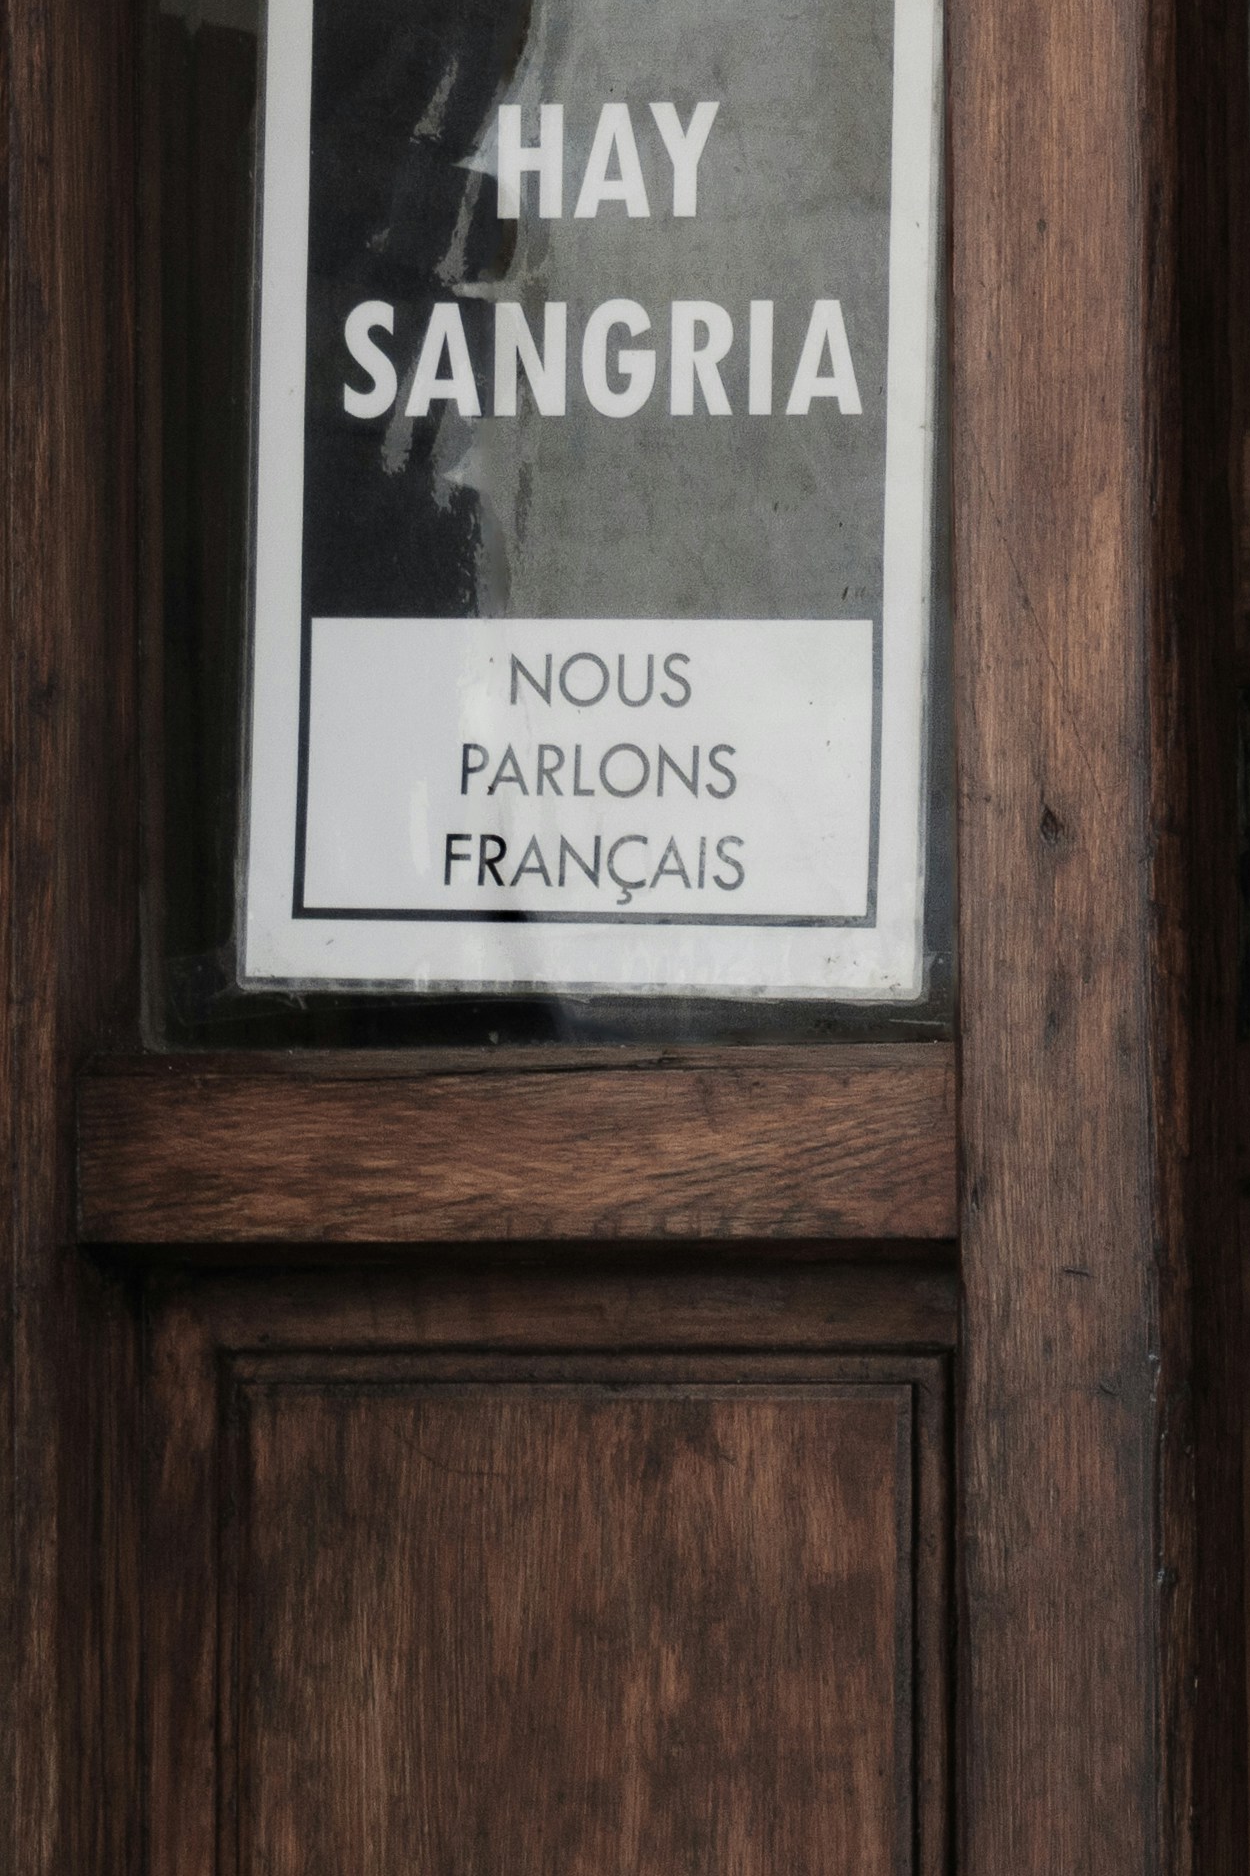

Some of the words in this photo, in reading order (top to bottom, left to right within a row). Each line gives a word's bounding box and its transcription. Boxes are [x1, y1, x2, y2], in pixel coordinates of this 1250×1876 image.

[497, 102, 720, 219] HAY
[343, 299, 863, 419] SANGRIA
[509, 652, 693, 708] NOUS
[460, 742, 738, 800] PARLONS
[443, 833, 746, 906] FRANÇAIS
